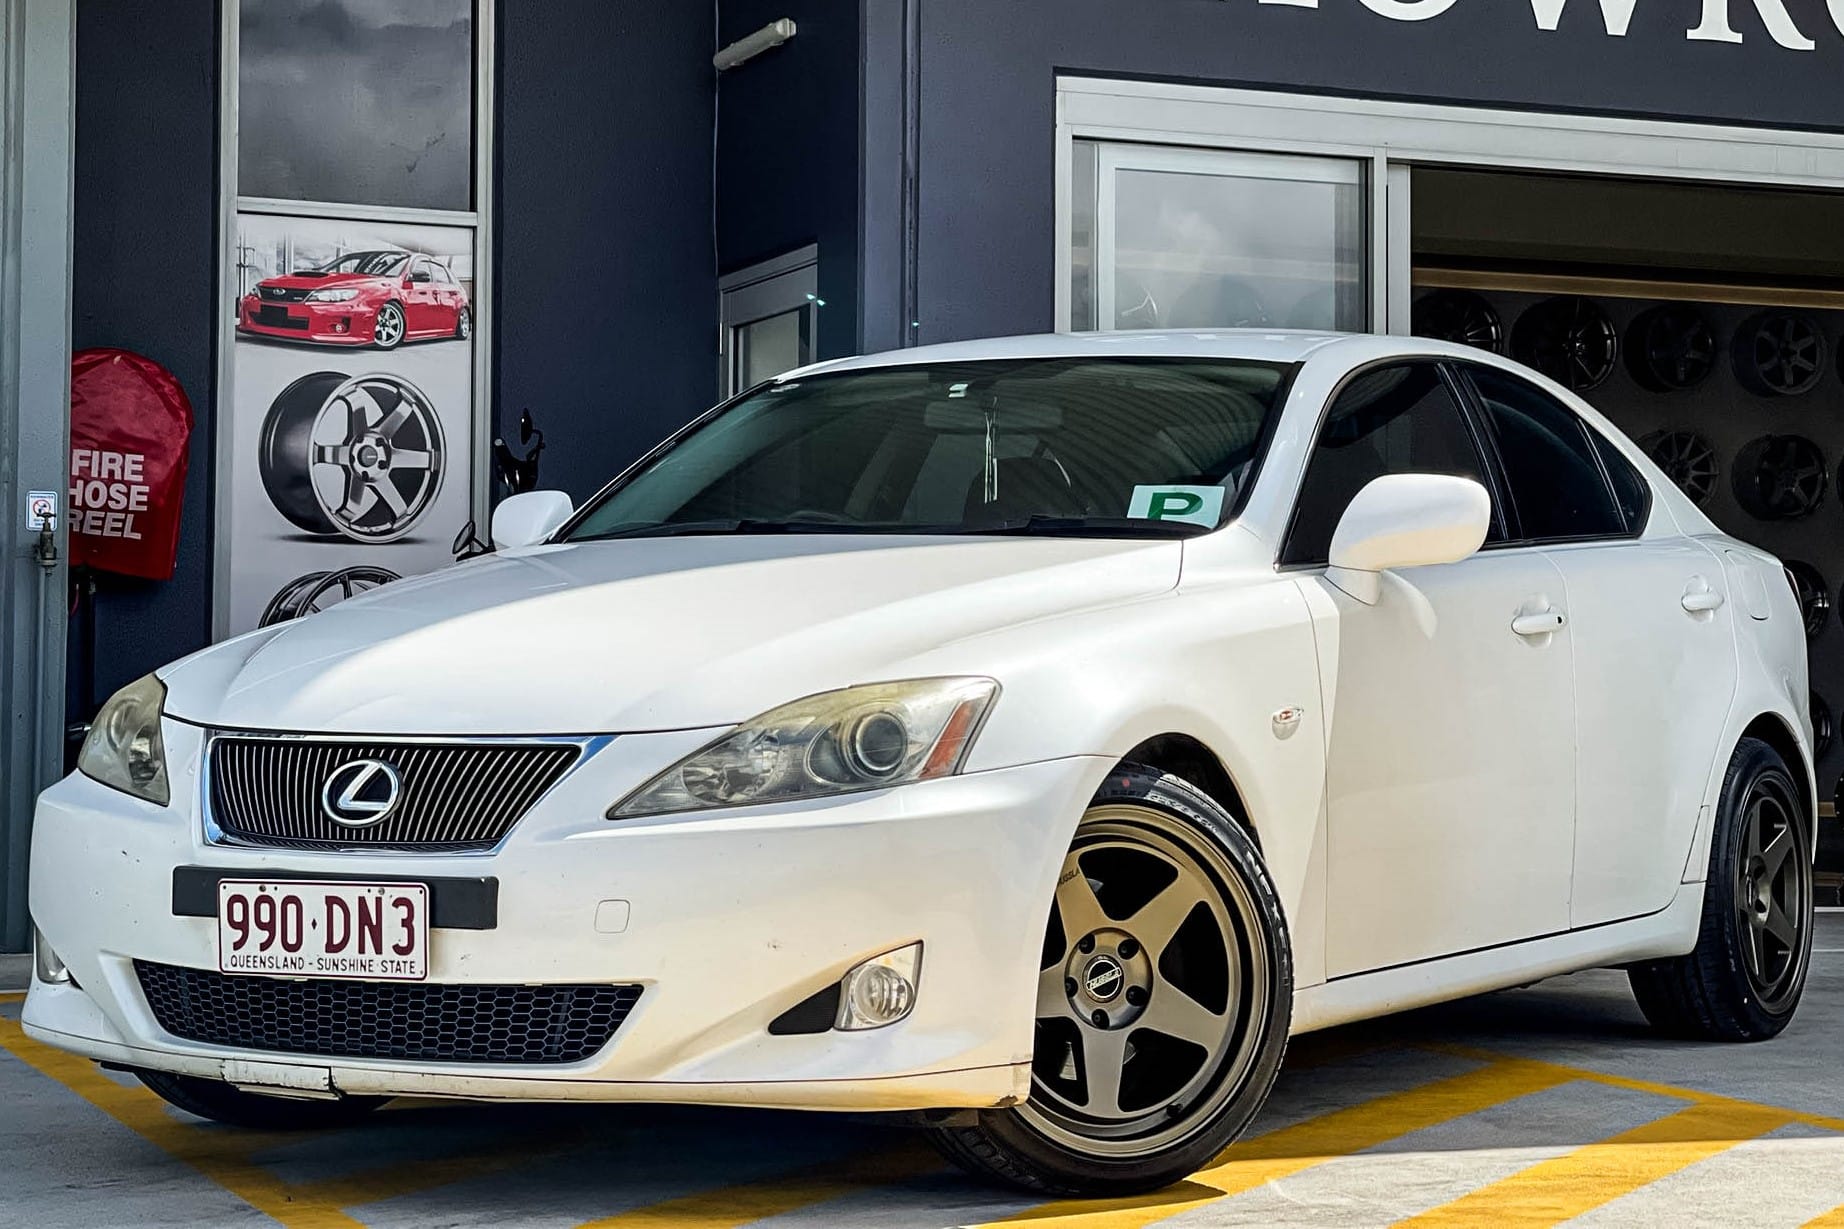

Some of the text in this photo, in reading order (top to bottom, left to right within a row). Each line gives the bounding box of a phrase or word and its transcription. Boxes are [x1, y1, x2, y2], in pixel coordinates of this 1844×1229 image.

[71, 448, 145, 482] FIRE
[69, 479, 150, 512] HOSE
[1147, 492, 1204, 520] P
[69, 508, 142, 540] REEL
[226, 894, 415, 956] 990 DN3
[230, 954, 304, 971] QUEENSLAND
[317, 957, 374, 973] SUNSHINE
[381, 960, 416, 975] STATE
